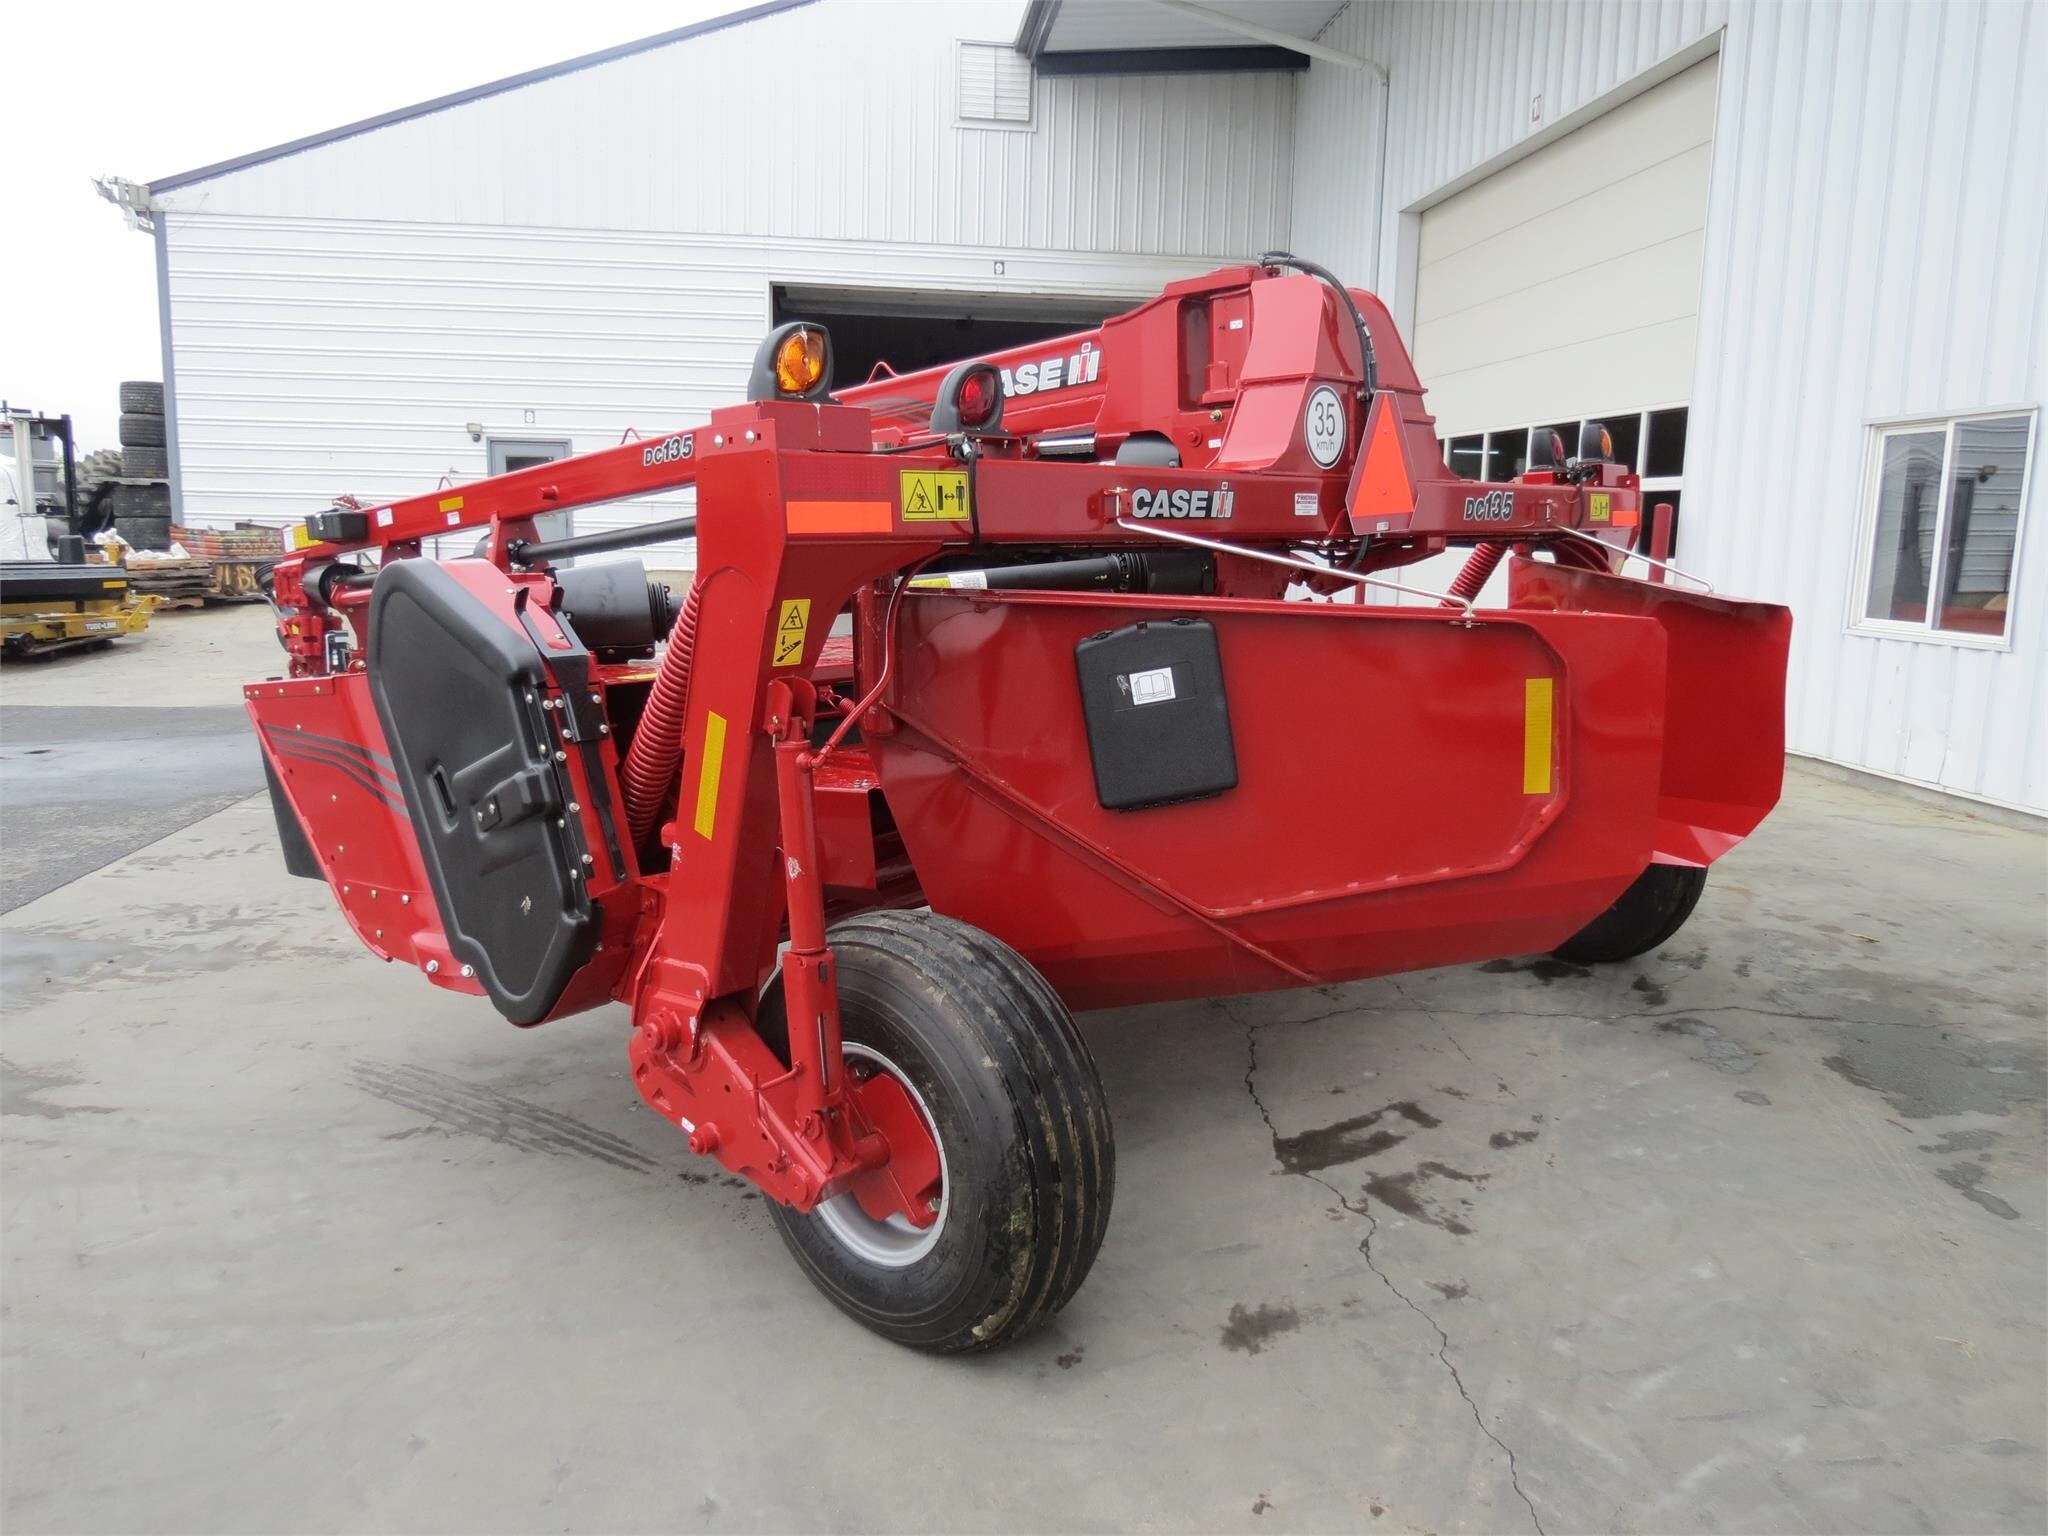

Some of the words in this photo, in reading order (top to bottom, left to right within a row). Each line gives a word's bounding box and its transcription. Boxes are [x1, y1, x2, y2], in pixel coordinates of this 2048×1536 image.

[995, 262, 1003, 274] 9
[1000, 358, 1063, 398] ASE
[526, 411, 534, 423] 8
[1315, 401, 1336, 437] 35
[643, 434, 693, 467] DC135
[1316, 440, 1335, 451] km/h
[1132, 488, 1209, 518] CASE
[1463, 490, 1514, 521] DC135
